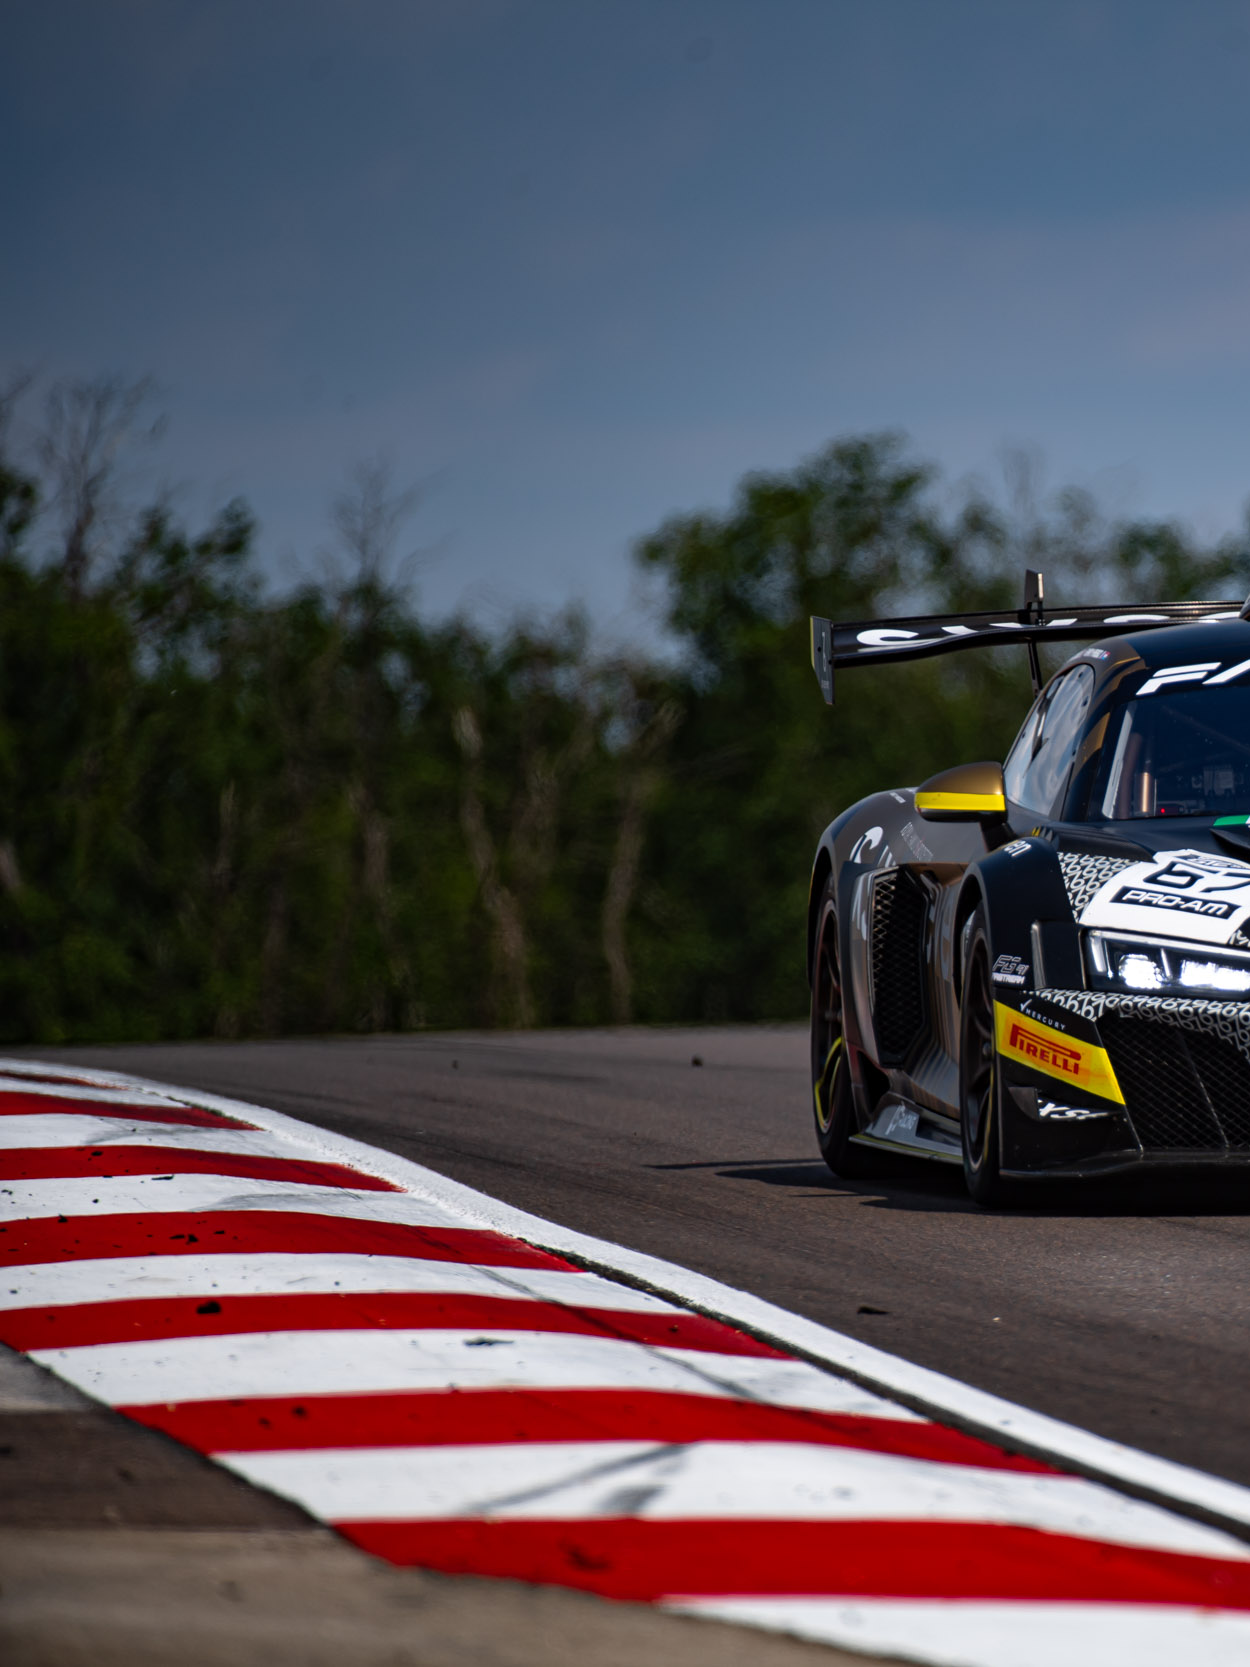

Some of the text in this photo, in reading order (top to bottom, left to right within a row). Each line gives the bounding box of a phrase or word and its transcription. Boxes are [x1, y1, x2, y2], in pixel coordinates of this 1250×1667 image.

[1122, 889, 1230, 916] PRO-AM
[1025, 1008, 1067, 1031] MERCURY
[1009, 1023, 1082, 1075] PIRELLI
